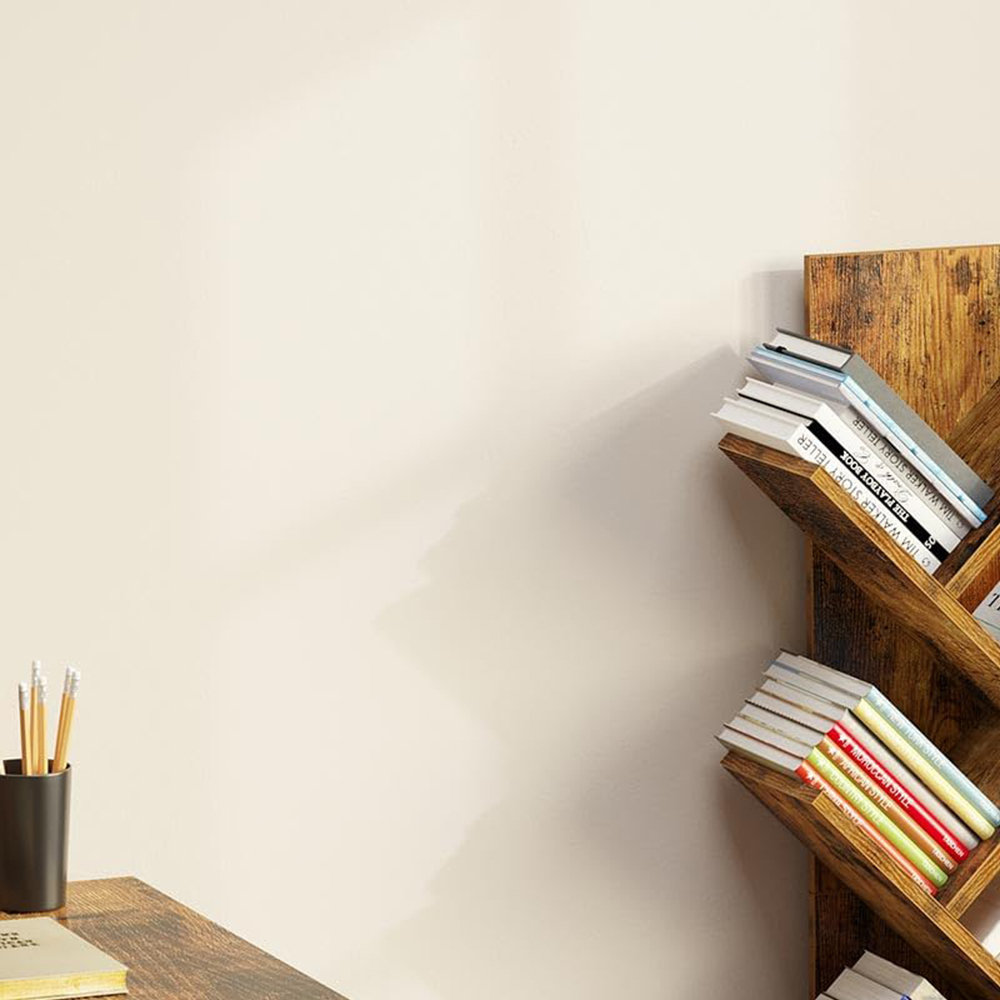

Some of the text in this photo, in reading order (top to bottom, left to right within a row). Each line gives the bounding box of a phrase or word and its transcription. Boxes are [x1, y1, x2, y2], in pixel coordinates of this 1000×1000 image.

[840, 451, 909, 521] THE PLAYBOY BOOK
[861, 498, 901, 538] WALKER
[851, 747, 890, 787] MOROCCAN
[890, 785, 911, 807] STYLE
